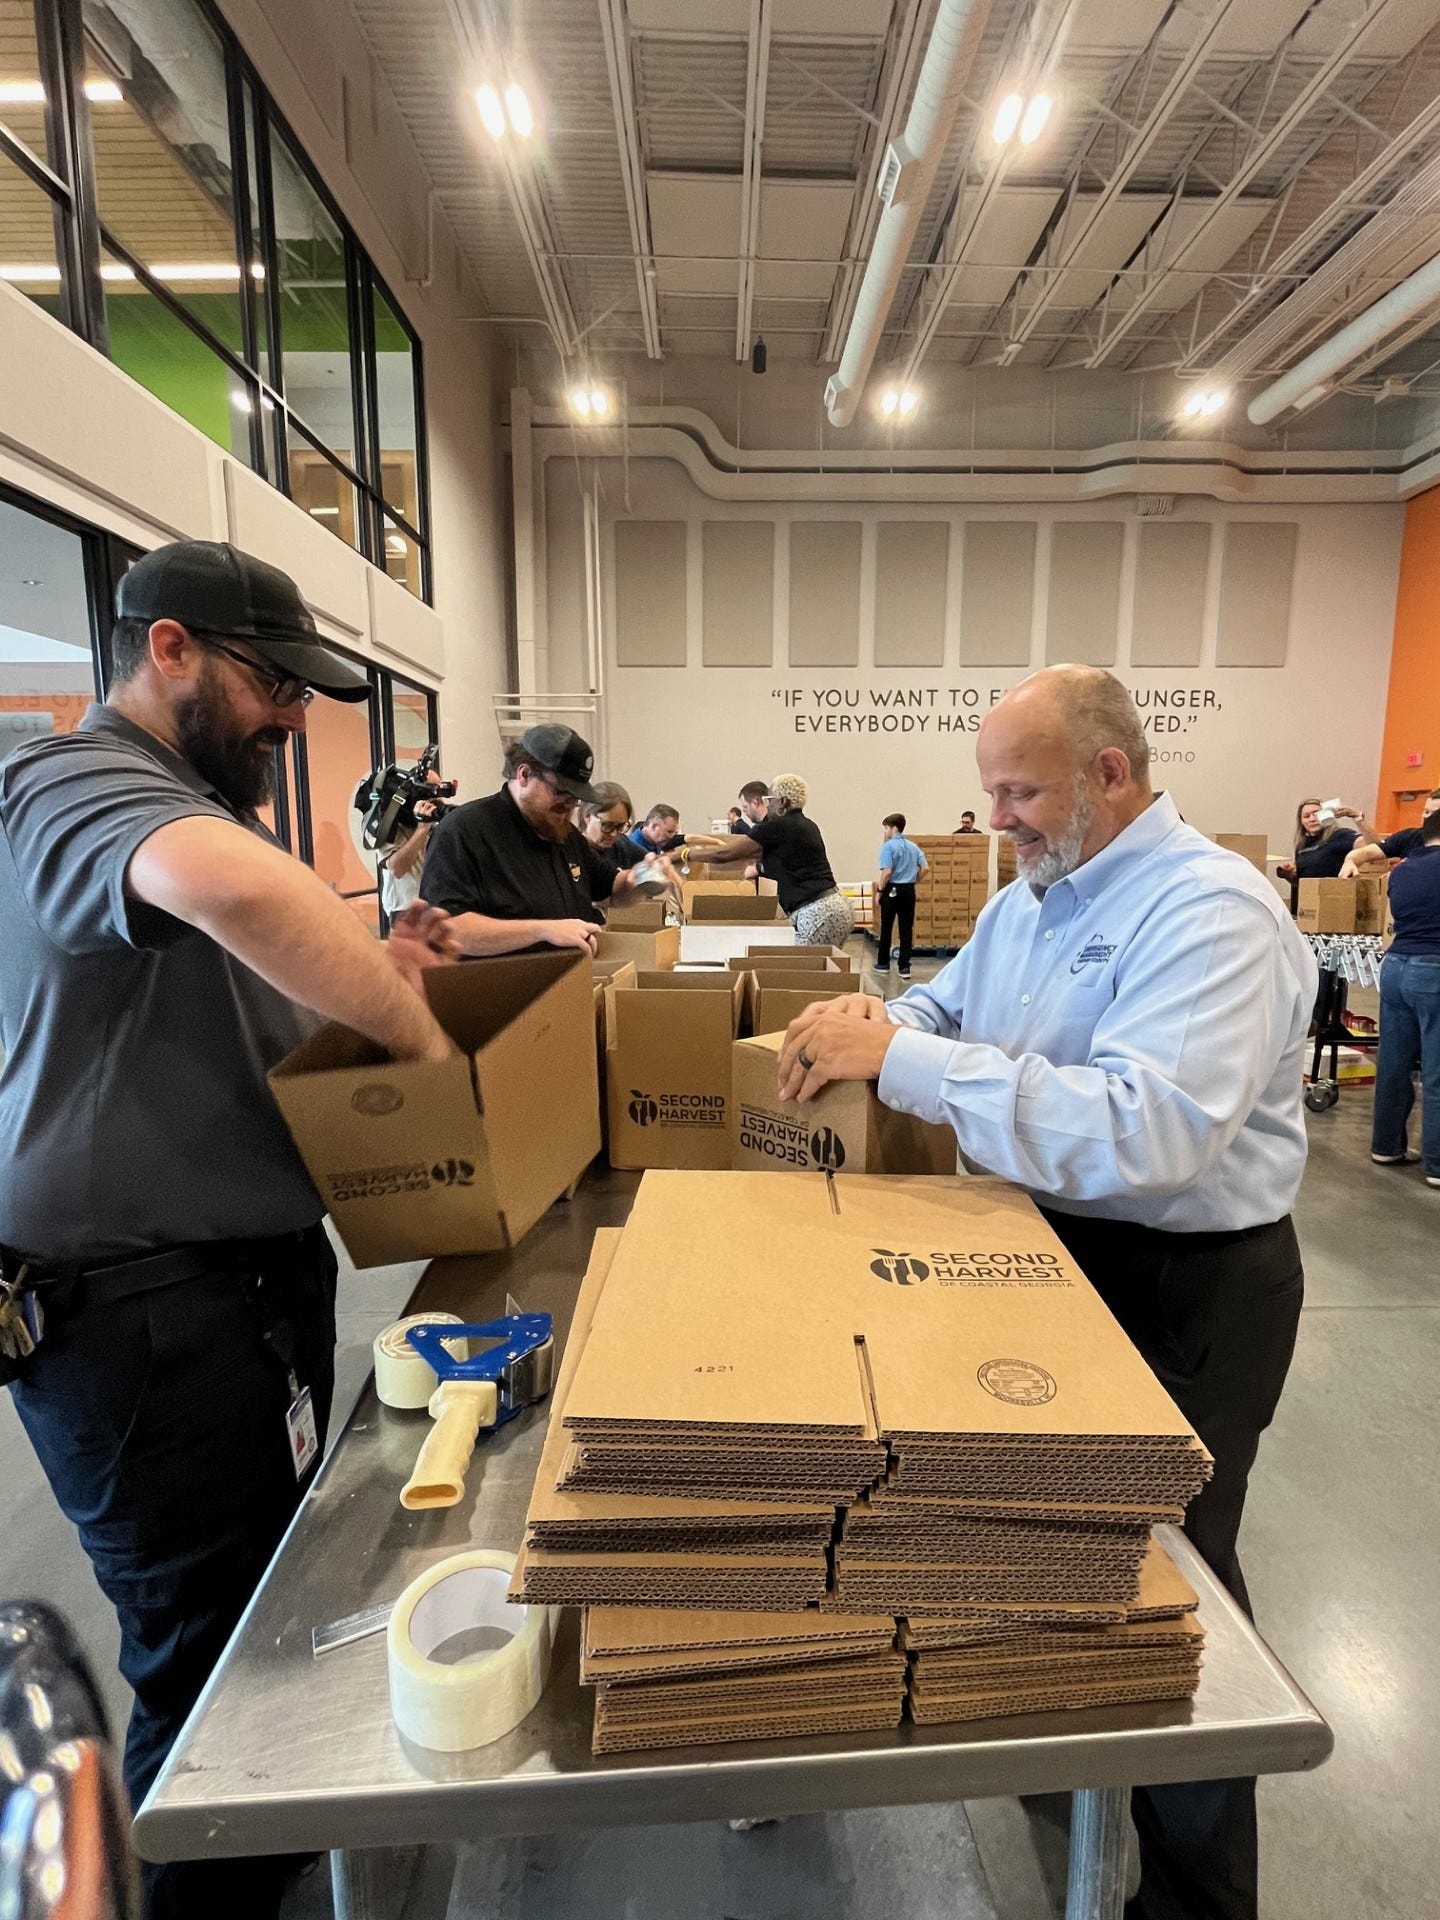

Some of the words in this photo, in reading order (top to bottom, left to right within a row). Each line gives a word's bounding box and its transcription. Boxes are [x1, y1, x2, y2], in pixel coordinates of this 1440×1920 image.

[772, 689, 803, 707] “IF
[812, 689, 860, 707] YOU
[869, 689, 939, 707] WANT
[948, 689, 979, 707] TO
[1128, 689, 1222, 711] UNGER,
[795, 714, 930, 732] EVERYBODY
[938, 714, 981, 732] HAS
[1148, 746, 1196, 763] Bono
[659, 1094, 725, 1108] SECOND
[659, 1108, 726, 1121] HARVEST
[740, 1114, 809, 1148] HARVEST
[740, 1131, 808, 1167] SECOND
[929, 1252, 1059, 1265] SECOND
[933, 1266, 1065, 1279] HARVEST
[1017, 1281, 1076, 1289] GEORGIA
